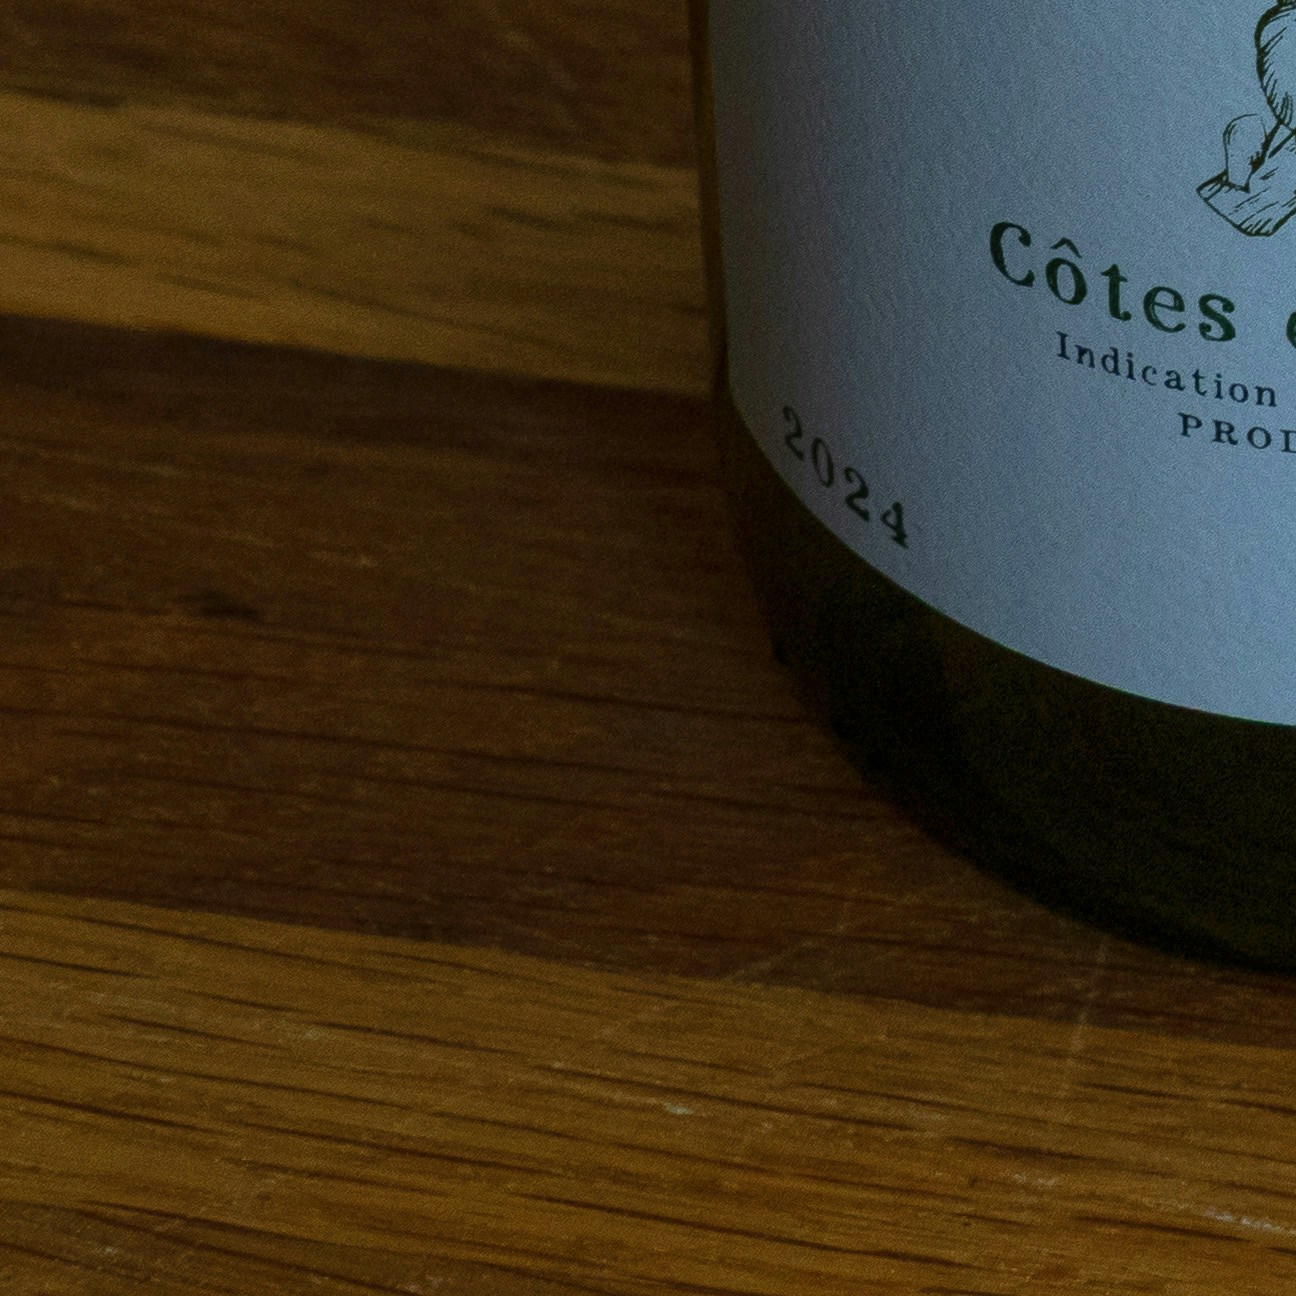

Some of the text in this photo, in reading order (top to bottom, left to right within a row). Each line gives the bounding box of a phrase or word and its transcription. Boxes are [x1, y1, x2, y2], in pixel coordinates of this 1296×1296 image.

[988, 220, 1238, 343] Côtes
[1055, 329, 1279, 408] Indication
[781, 405, 910, 550] 2024
